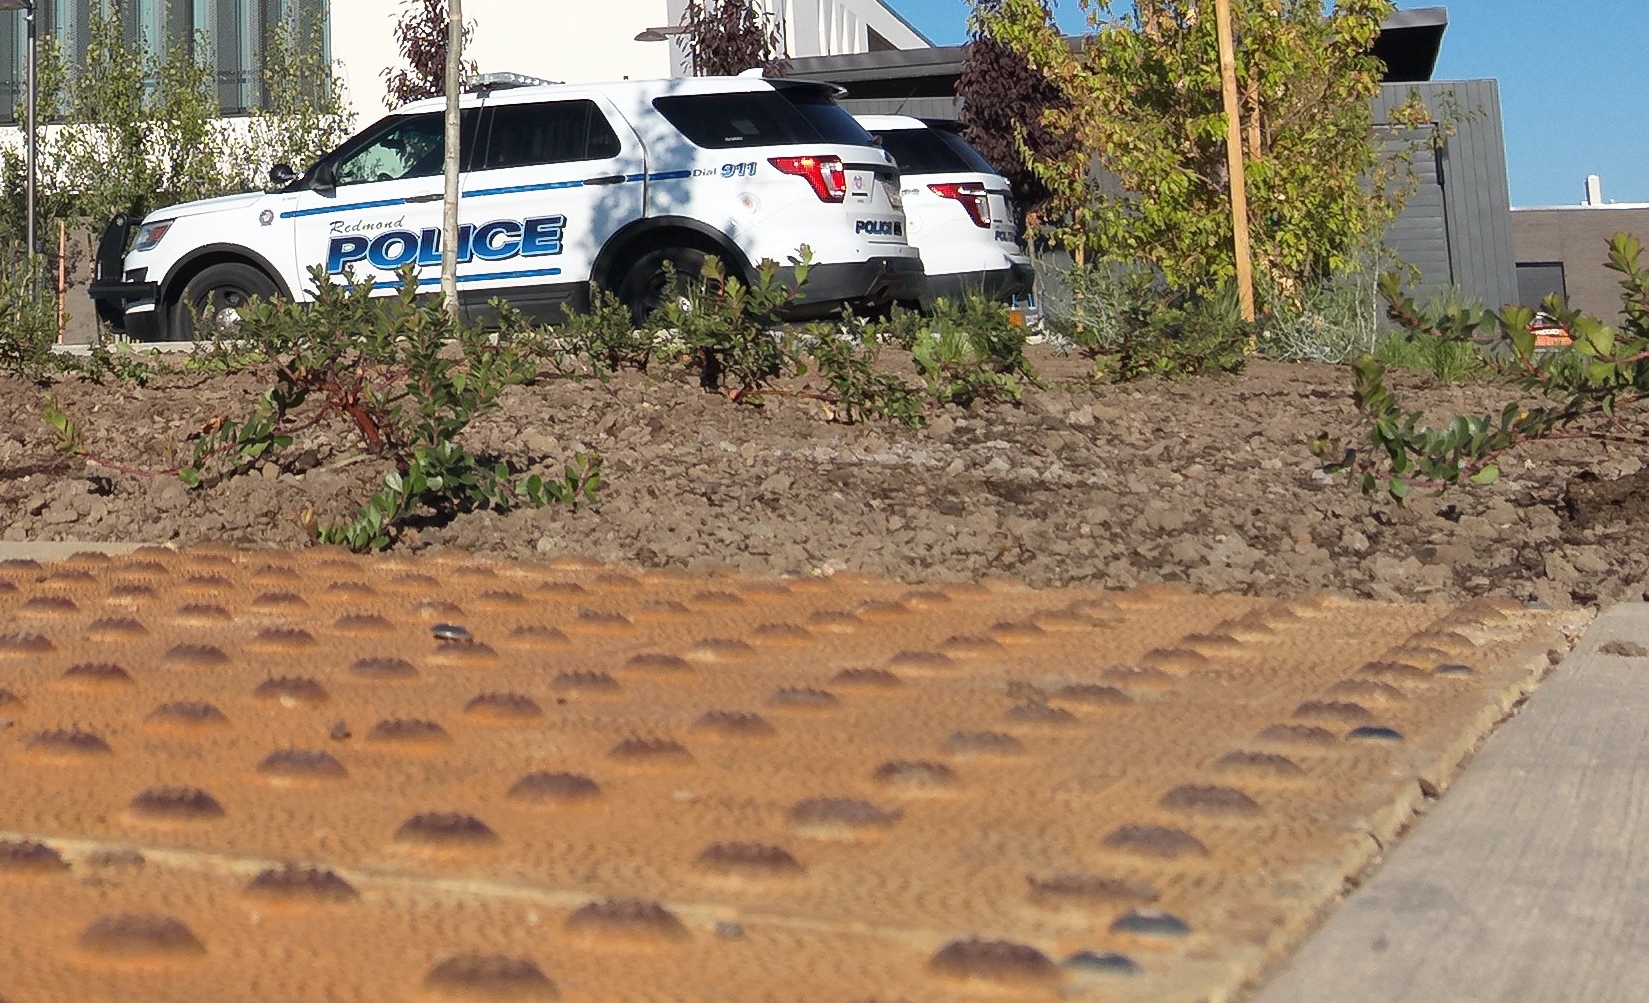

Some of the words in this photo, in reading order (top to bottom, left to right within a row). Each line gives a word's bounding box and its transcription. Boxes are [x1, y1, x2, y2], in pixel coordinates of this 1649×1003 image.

[692, 167, 717, 177] Dial
[721, 161, 758, 178] 911
[329, 214, 406, 235] Redmond
[326, 213, 567, 275] POLICE
